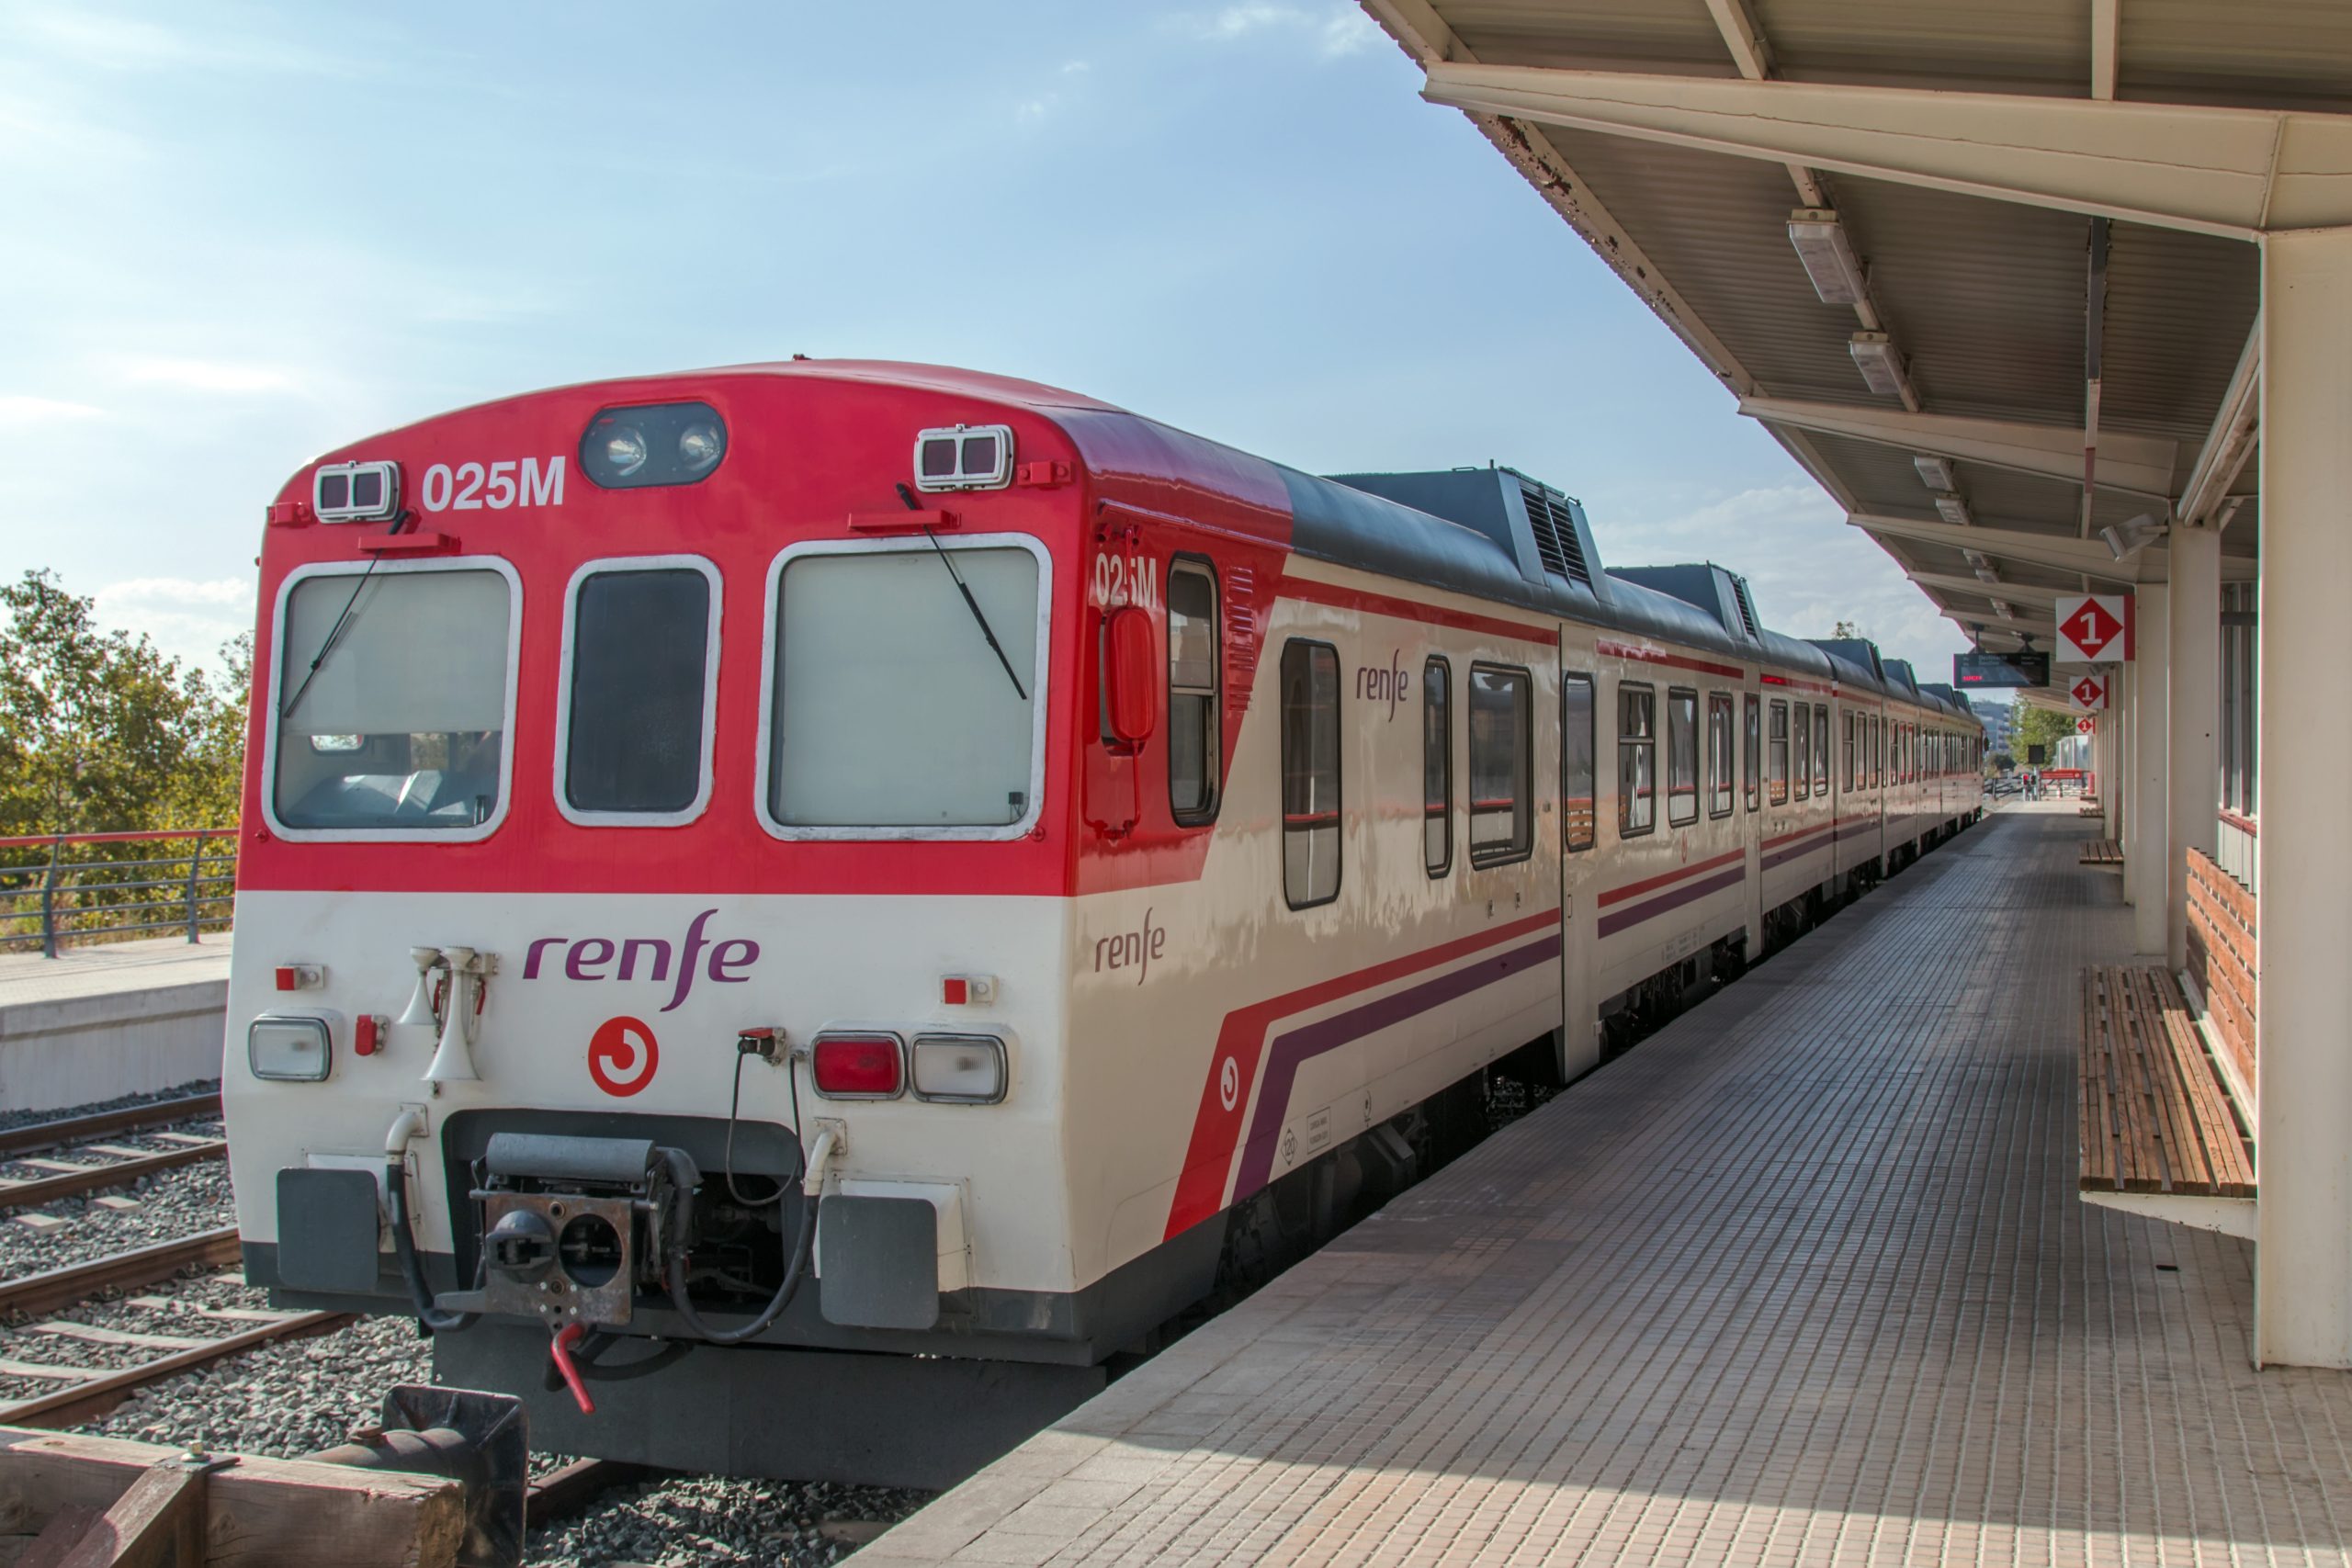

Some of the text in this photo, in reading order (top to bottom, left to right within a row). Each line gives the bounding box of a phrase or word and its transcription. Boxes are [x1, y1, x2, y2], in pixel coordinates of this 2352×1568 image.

[422, 456, 566, 513] 025M
[2080, 612, 2102, 645] 1
[1356, 649, 1408, 723] renfe
[2081, 683, 2093, 701] 1
[2082, 721, 2087, 731] 1
[522, 908, 760, 1012] renfe
[1094, 907, 1165, 987] renfe
